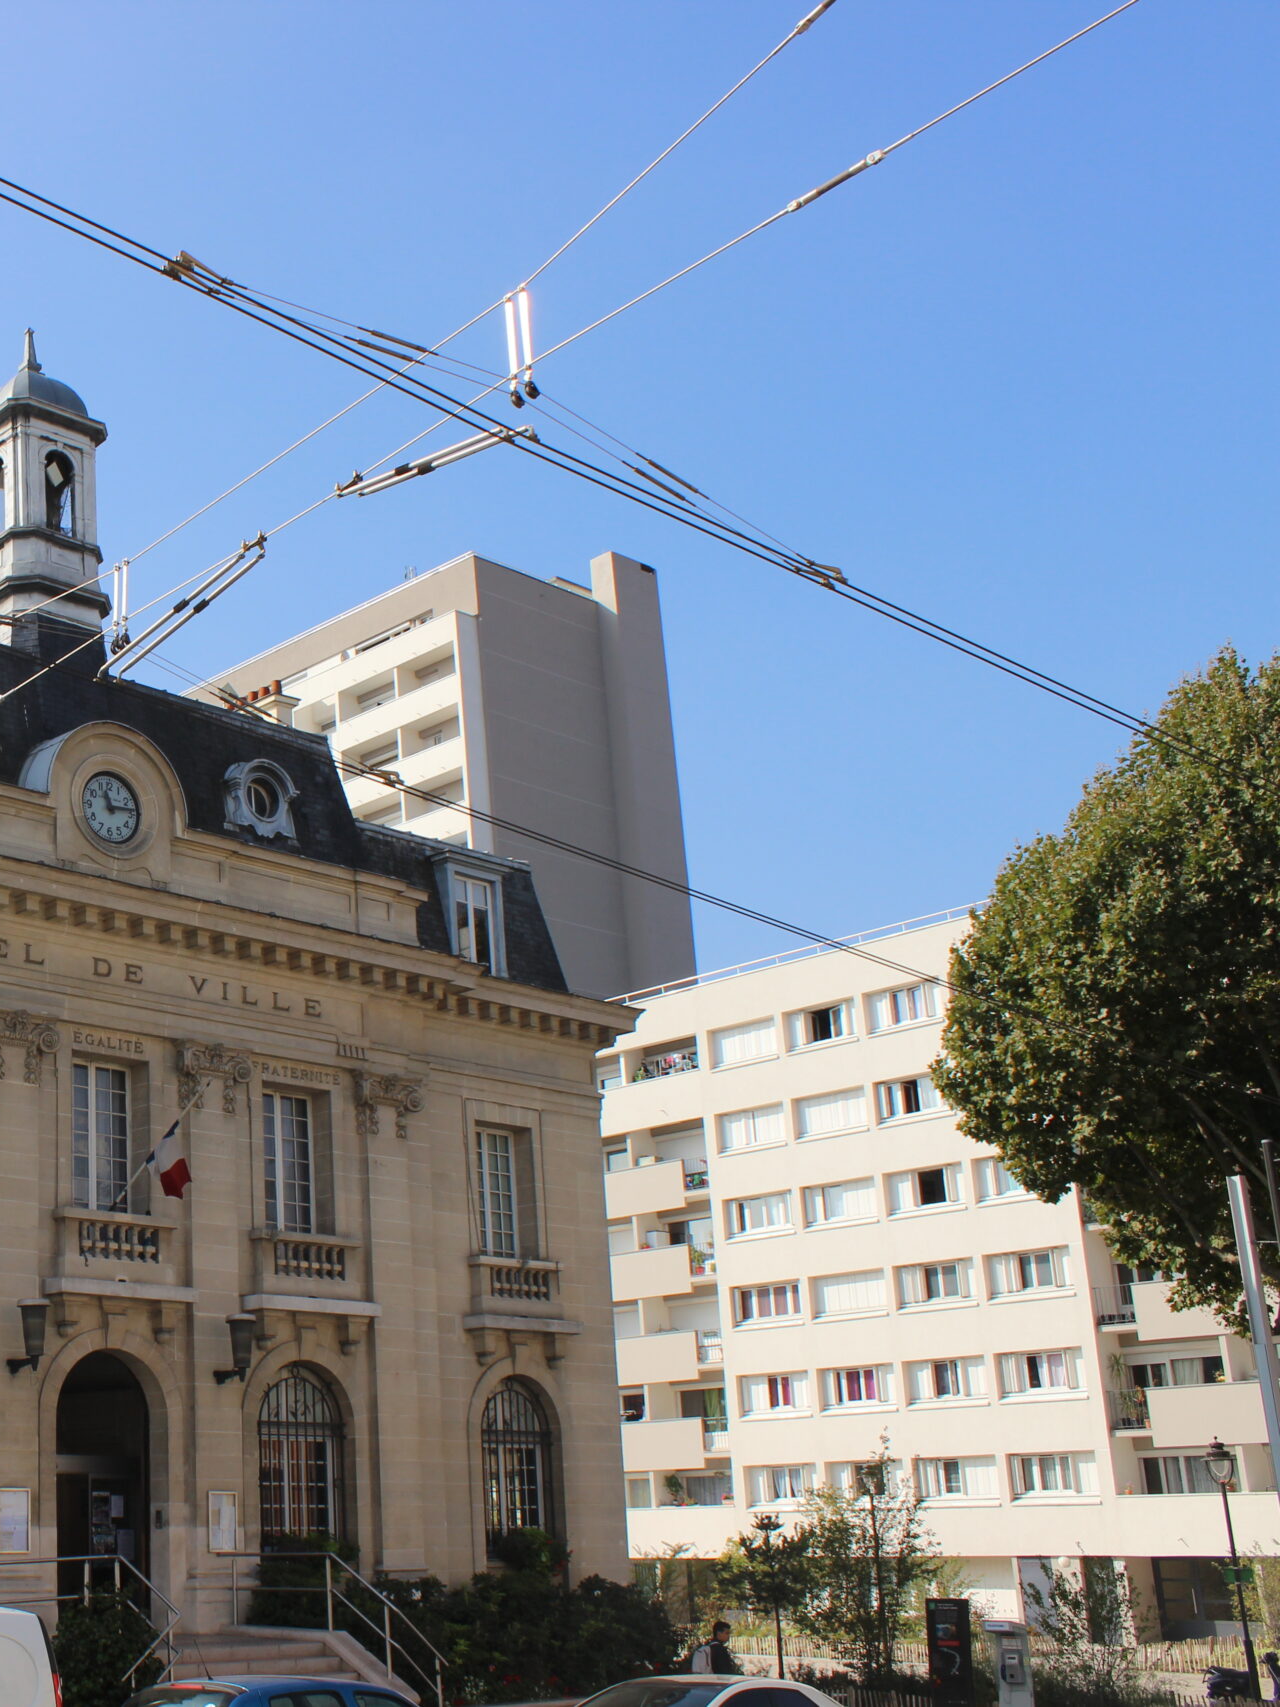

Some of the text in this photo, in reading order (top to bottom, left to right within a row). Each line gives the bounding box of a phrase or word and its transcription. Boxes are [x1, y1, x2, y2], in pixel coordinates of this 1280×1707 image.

[98, 782, 103, 791] 11
[106, 781, 113, 791] 12
[90, 789, 97, 798] 10
[86, 799, 93, 809] 9
[123, 797, 129, 807] 2
[90, 812, 96, 821] 8
[98, 822, 104, 832] 7
[123, 820, 130, 829] 4
[107, 827, 113, 837] 6
[116, 827, 122, 836] 5
[92, 956, 144, 985] DE
[188, 974, 321, 1018] VILLE
[72, 1027, 144, 1054] ÉGALITÉ
